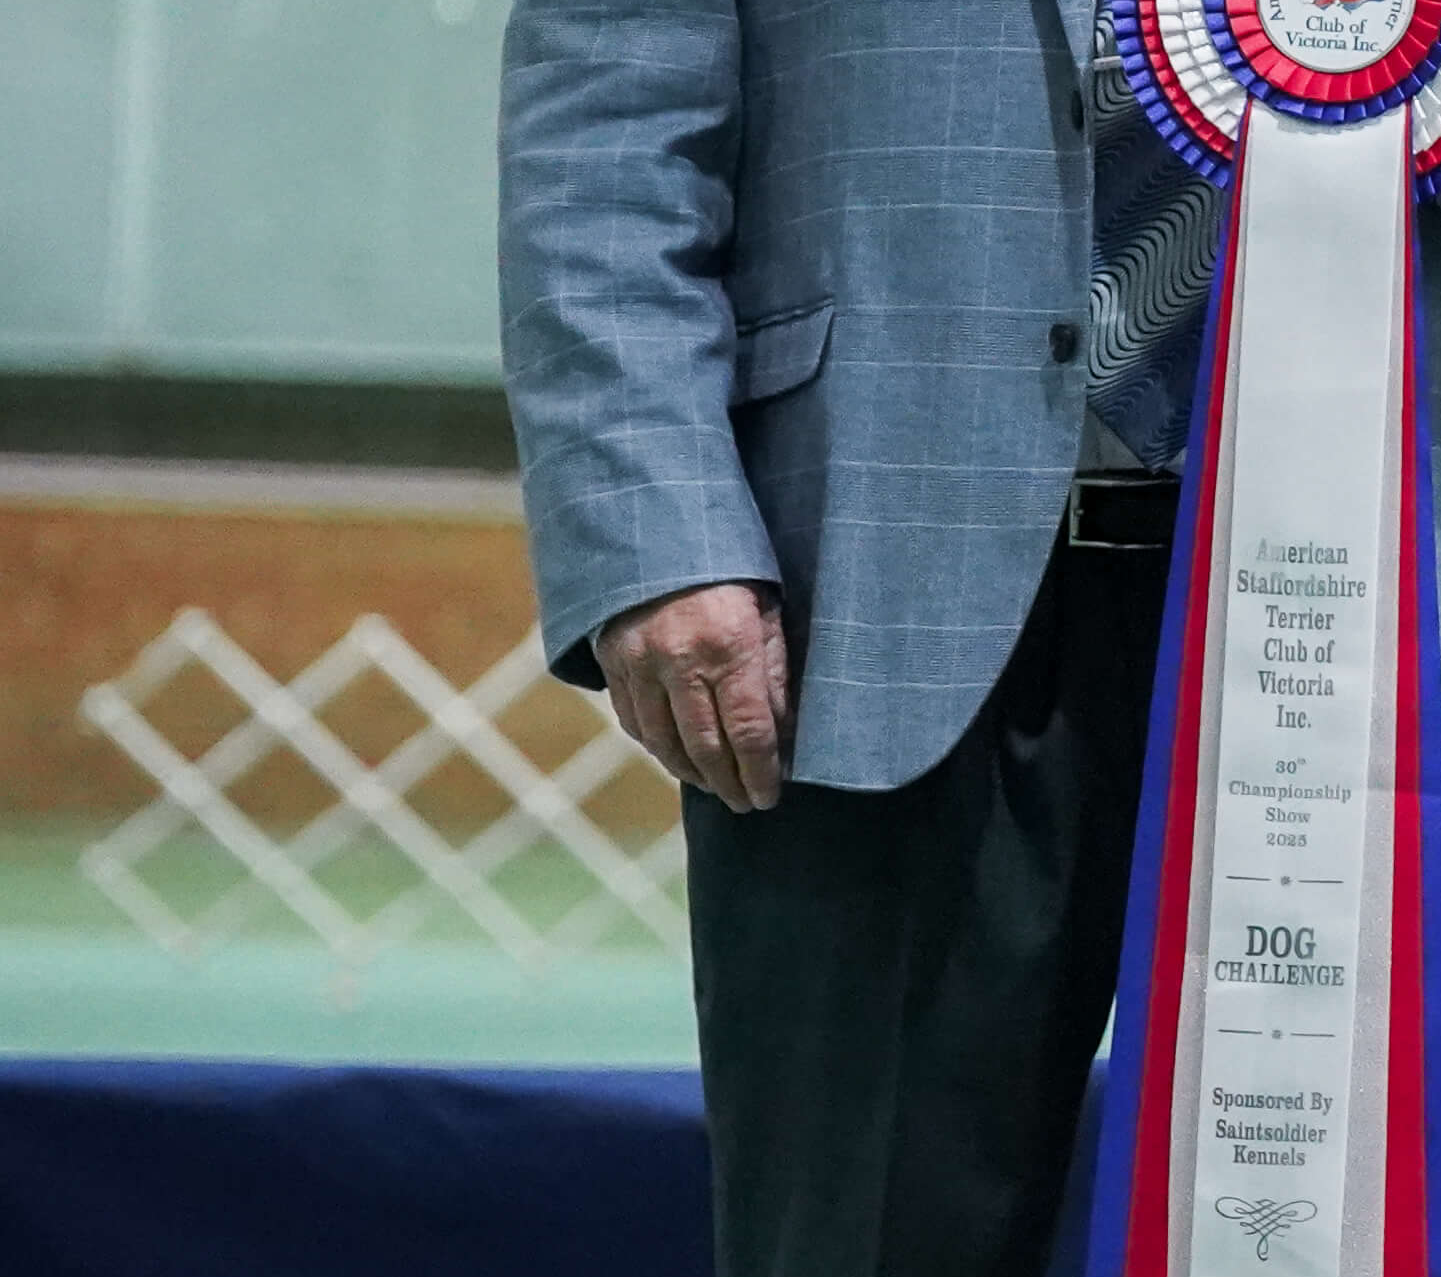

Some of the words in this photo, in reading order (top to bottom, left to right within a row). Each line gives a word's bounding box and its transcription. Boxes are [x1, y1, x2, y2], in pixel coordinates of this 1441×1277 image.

[1306, 16, 1344, 33] Club
[1350, 19, 1367, 34] of
[1285, 31, 1347, 50] Victoria
[1352, 36, 1384, 53] Inc.
[1236, 569, 1367, 598] Staffordshire
[1265, 605, 1334, 630] Terrier
[1263, 638, 1308, 662] Club
[1315, 640, 1335, 663] of
[1257, 670, 1334, 696] Victoria
[1275, 705, 1312, 729] Inc.
[1228, 780, 1351, 802] Championship
[1265, 807, 1311, 824] Show
[1266, 833, 1307, 848] 2025
[1245, 925, 1316, 959] DOG
[1214, 960, 1345, 987] CHALLENGE
[1212, 1087, 1305, 1112] Sponsored
[1310, 1092, 1333, 1115] By
[1215, 1119, 1327, 1143] Saintsoldier
[1232, 1144, 1306, 1167] Kennels
